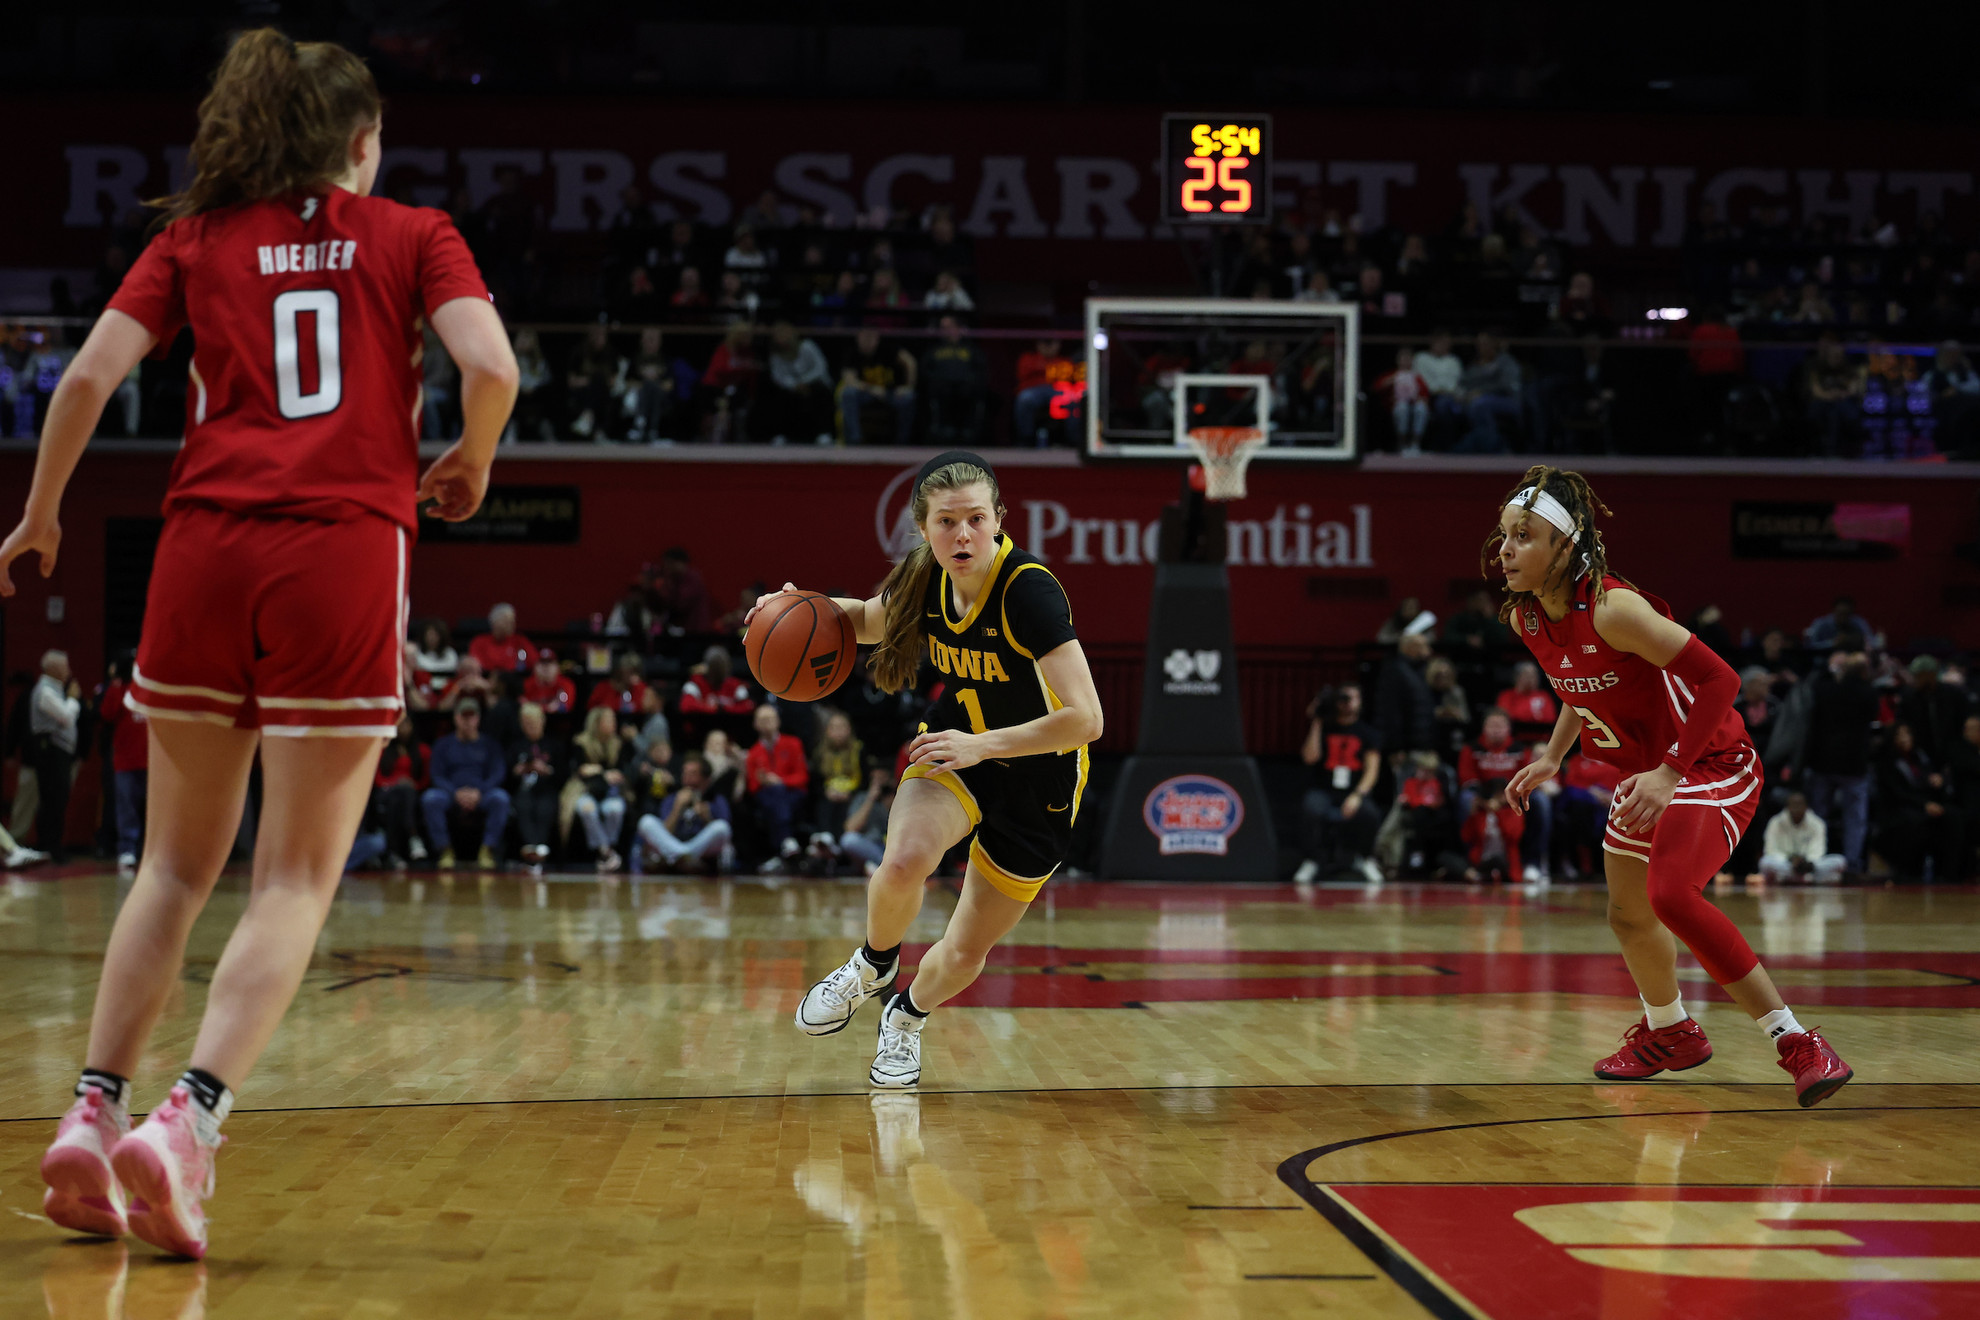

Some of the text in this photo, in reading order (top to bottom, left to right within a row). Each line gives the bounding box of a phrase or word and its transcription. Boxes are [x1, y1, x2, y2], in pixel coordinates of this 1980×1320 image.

[1191, 124, 1260, 157] 5:54
[62, 145, 734, 231] RGERS
[1181, 157, 1251, 213] 25
[257, 239, 358, 276] HUERTER
[273, 288, 342, 419] 0
[1021, 499, 1376, 568] Pruntial
[928, 633, 1011, 683] IOWA
[955, 687, 991, 735] 1
[1572, 705, 1622, 749] 3
